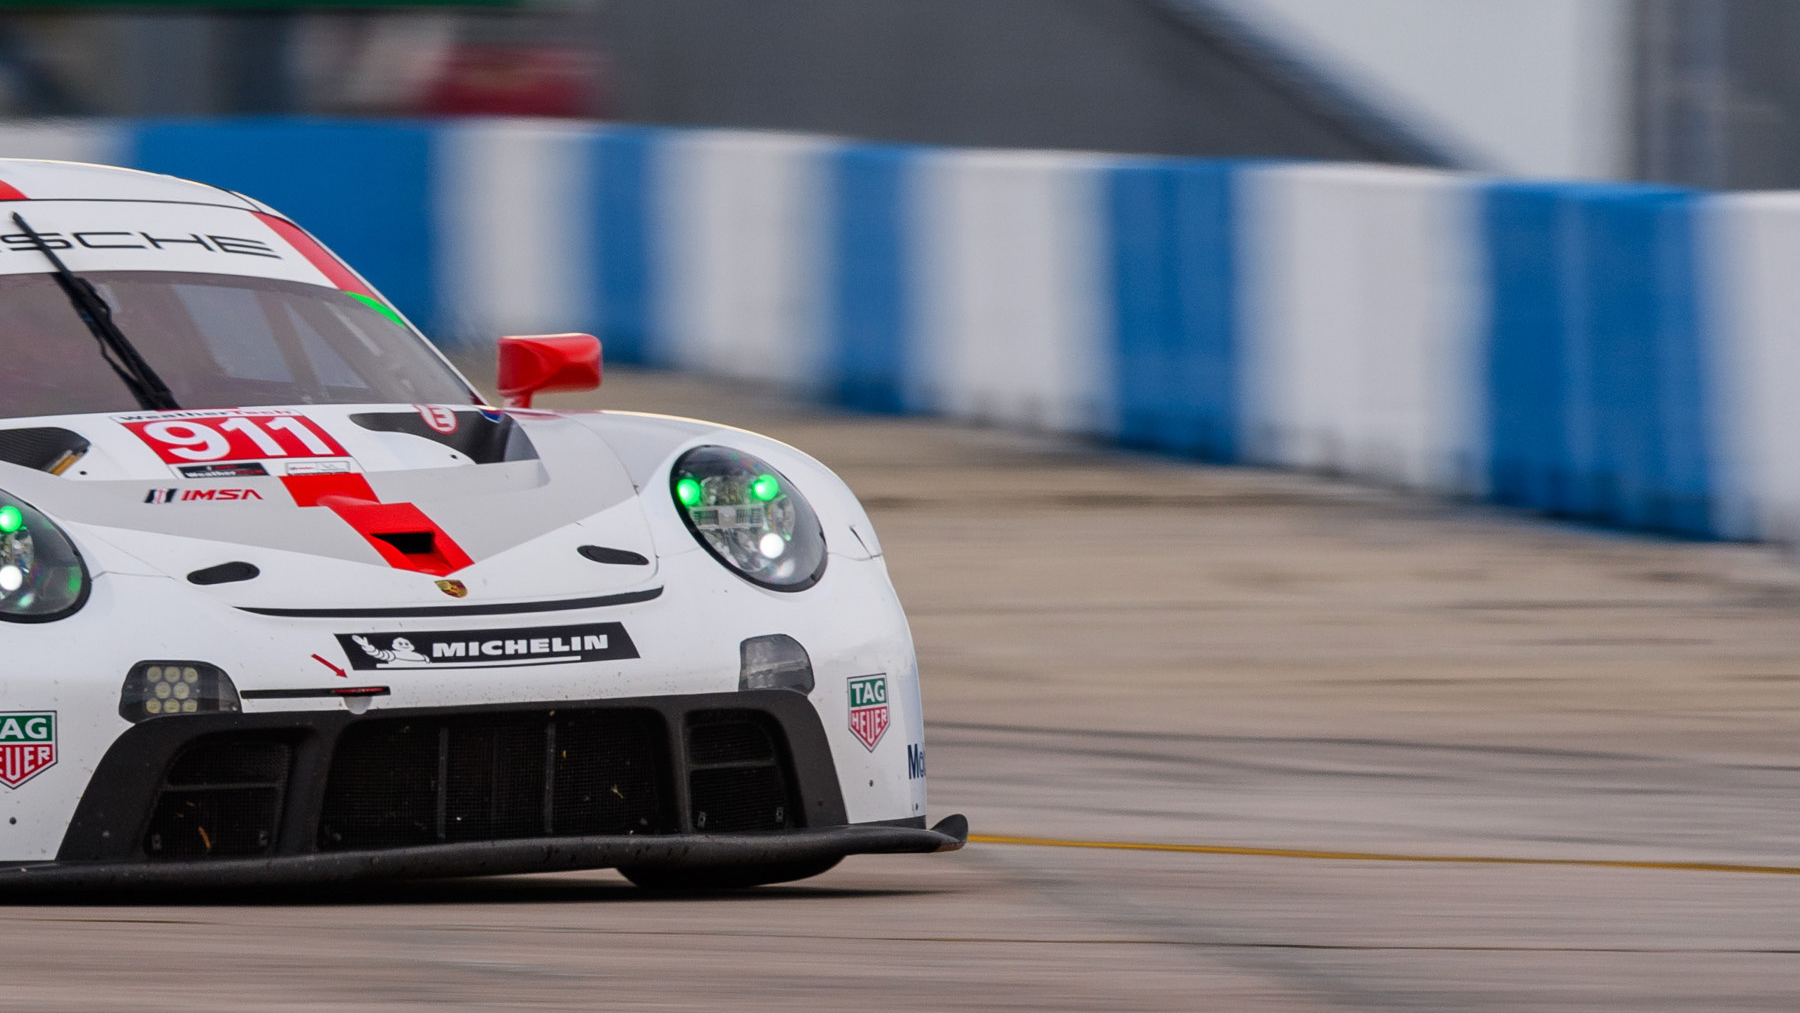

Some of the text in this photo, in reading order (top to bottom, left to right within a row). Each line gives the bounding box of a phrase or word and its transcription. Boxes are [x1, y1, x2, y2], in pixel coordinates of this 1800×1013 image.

[144, 416, 335, 461] 911
[181, 489, 264, 501] IMSA
[432, 635, 608, 657] MICHELIN
[851, 680, 886, 704] TAG
[851, 708, 888, 744] HEUER
